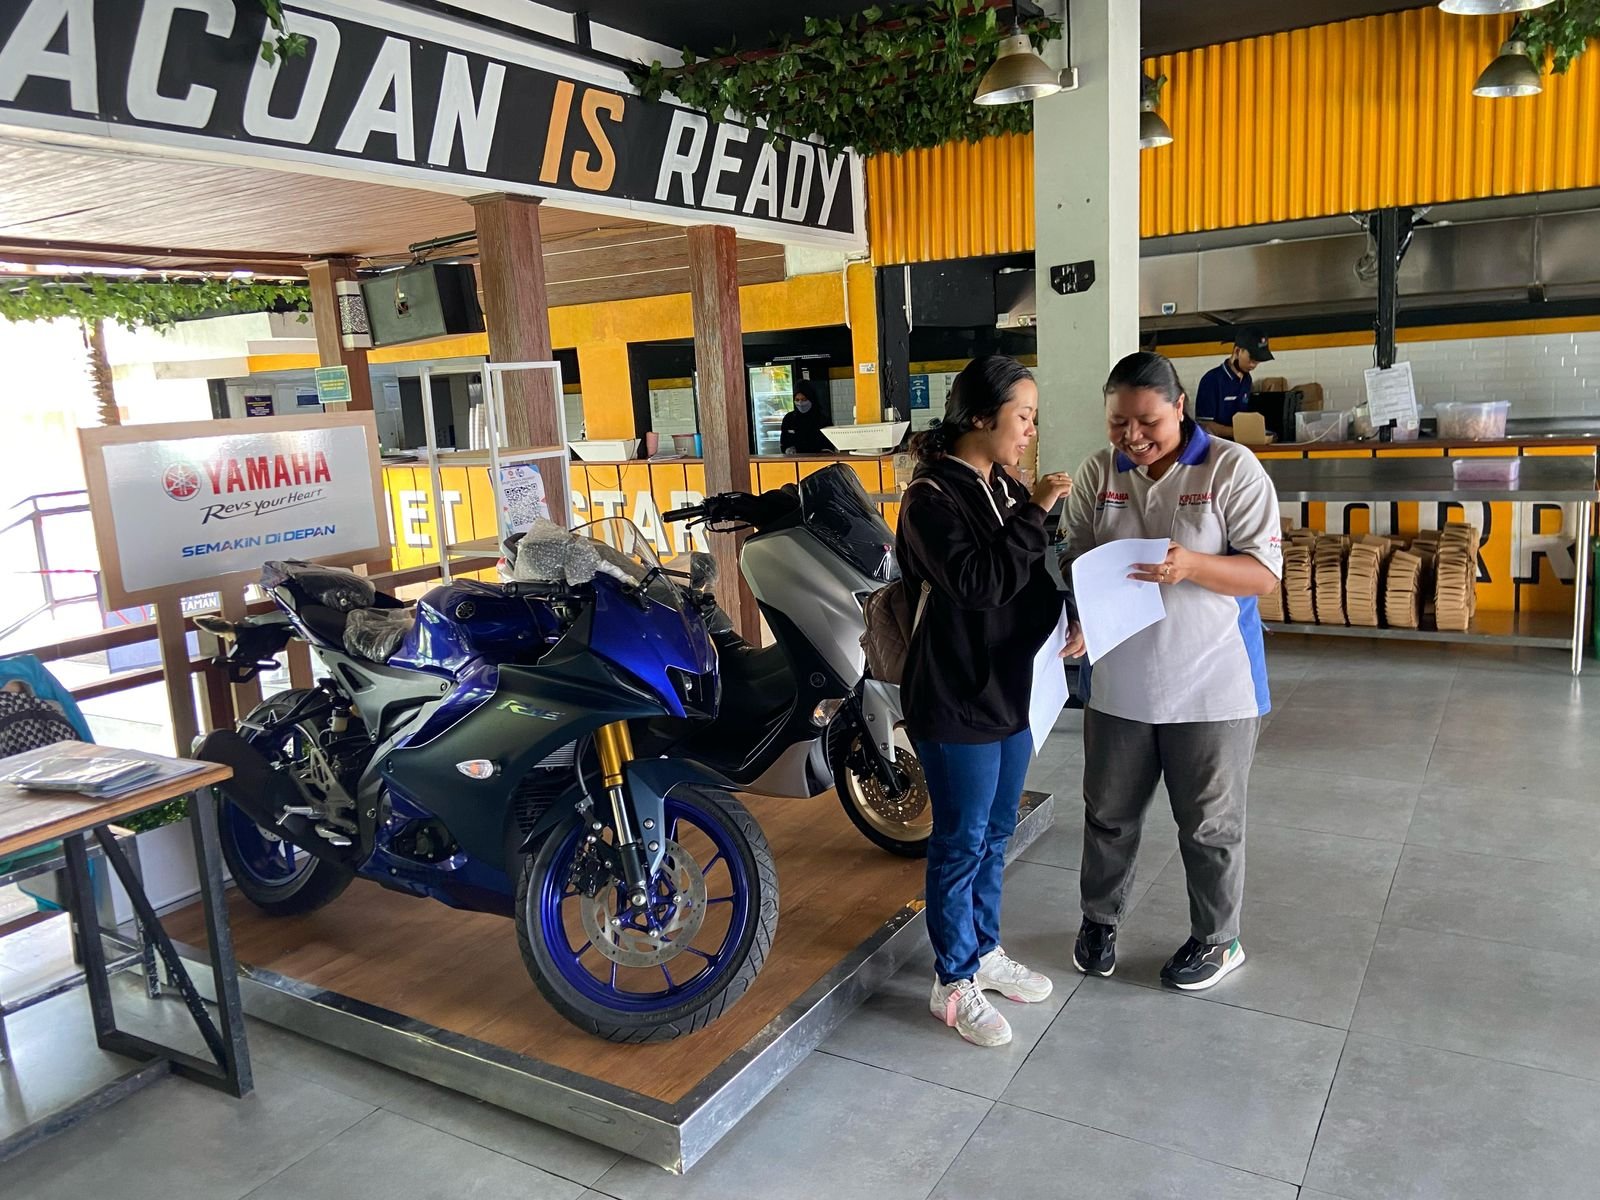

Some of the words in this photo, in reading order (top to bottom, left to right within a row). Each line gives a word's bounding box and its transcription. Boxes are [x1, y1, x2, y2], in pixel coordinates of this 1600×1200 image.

[539, 79, 625, 192] IS
[655, 108, 846, 226] READY
[202, 450, 332, 495] YAMAHA
[200, 499, 253, 525] Revs
[288, 488, 323, 503] Heart
[284, 524, 336, 542] DEPAN
[181, 597, 217, 612] TAMAN
